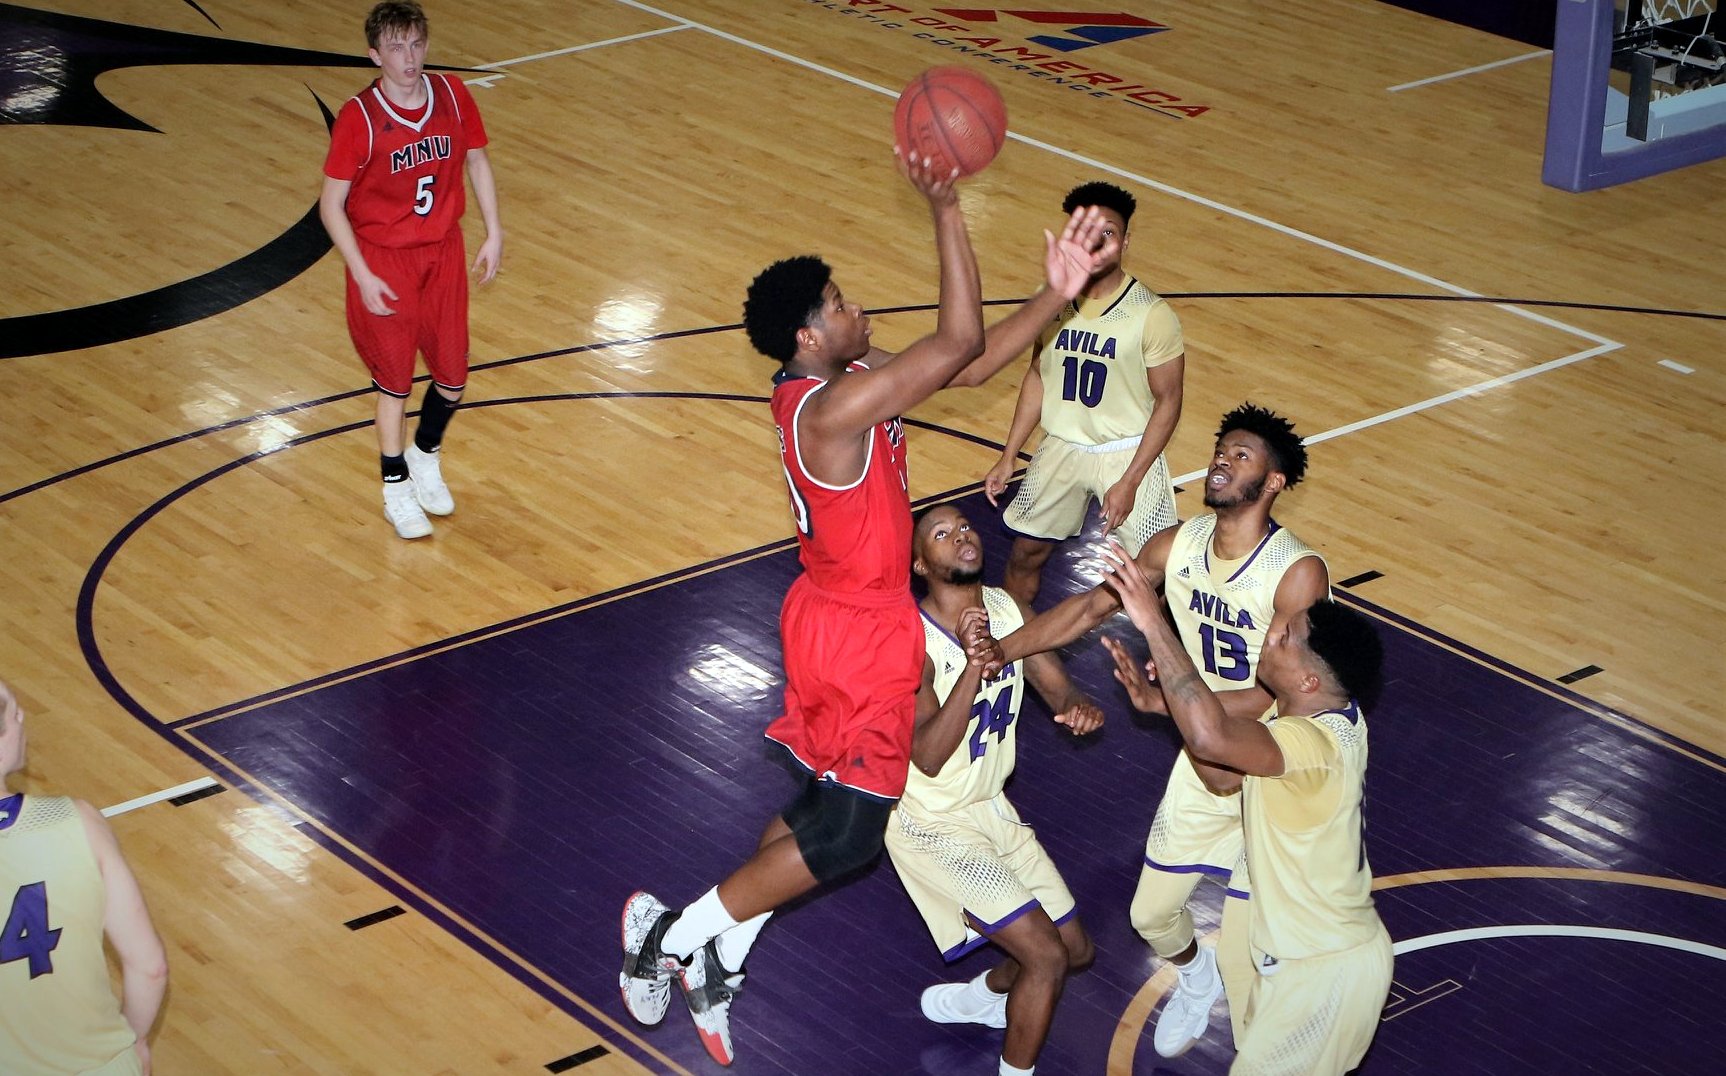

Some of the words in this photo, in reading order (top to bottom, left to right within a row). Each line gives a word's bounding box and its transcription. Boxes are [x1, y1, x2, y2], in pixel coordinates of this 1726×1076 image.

[909, 17, 971, 32] OF
[954, 37, 1211, 118] AMERICA
[912, 32, 1113, 98] CONFERENCE
[390, 135, 451, 174] MNU
[413, 175, 435, 216] 5
[1055, 328, 1117, 360] AVILA
[1062, 356, 1108, 408] 10
[1189, 588, 1257, 631] AVILA
[1198, 622, 1251, 682] 13
[969, 684, 1016, 765] 24
[0, 880, 64, 980] 4
